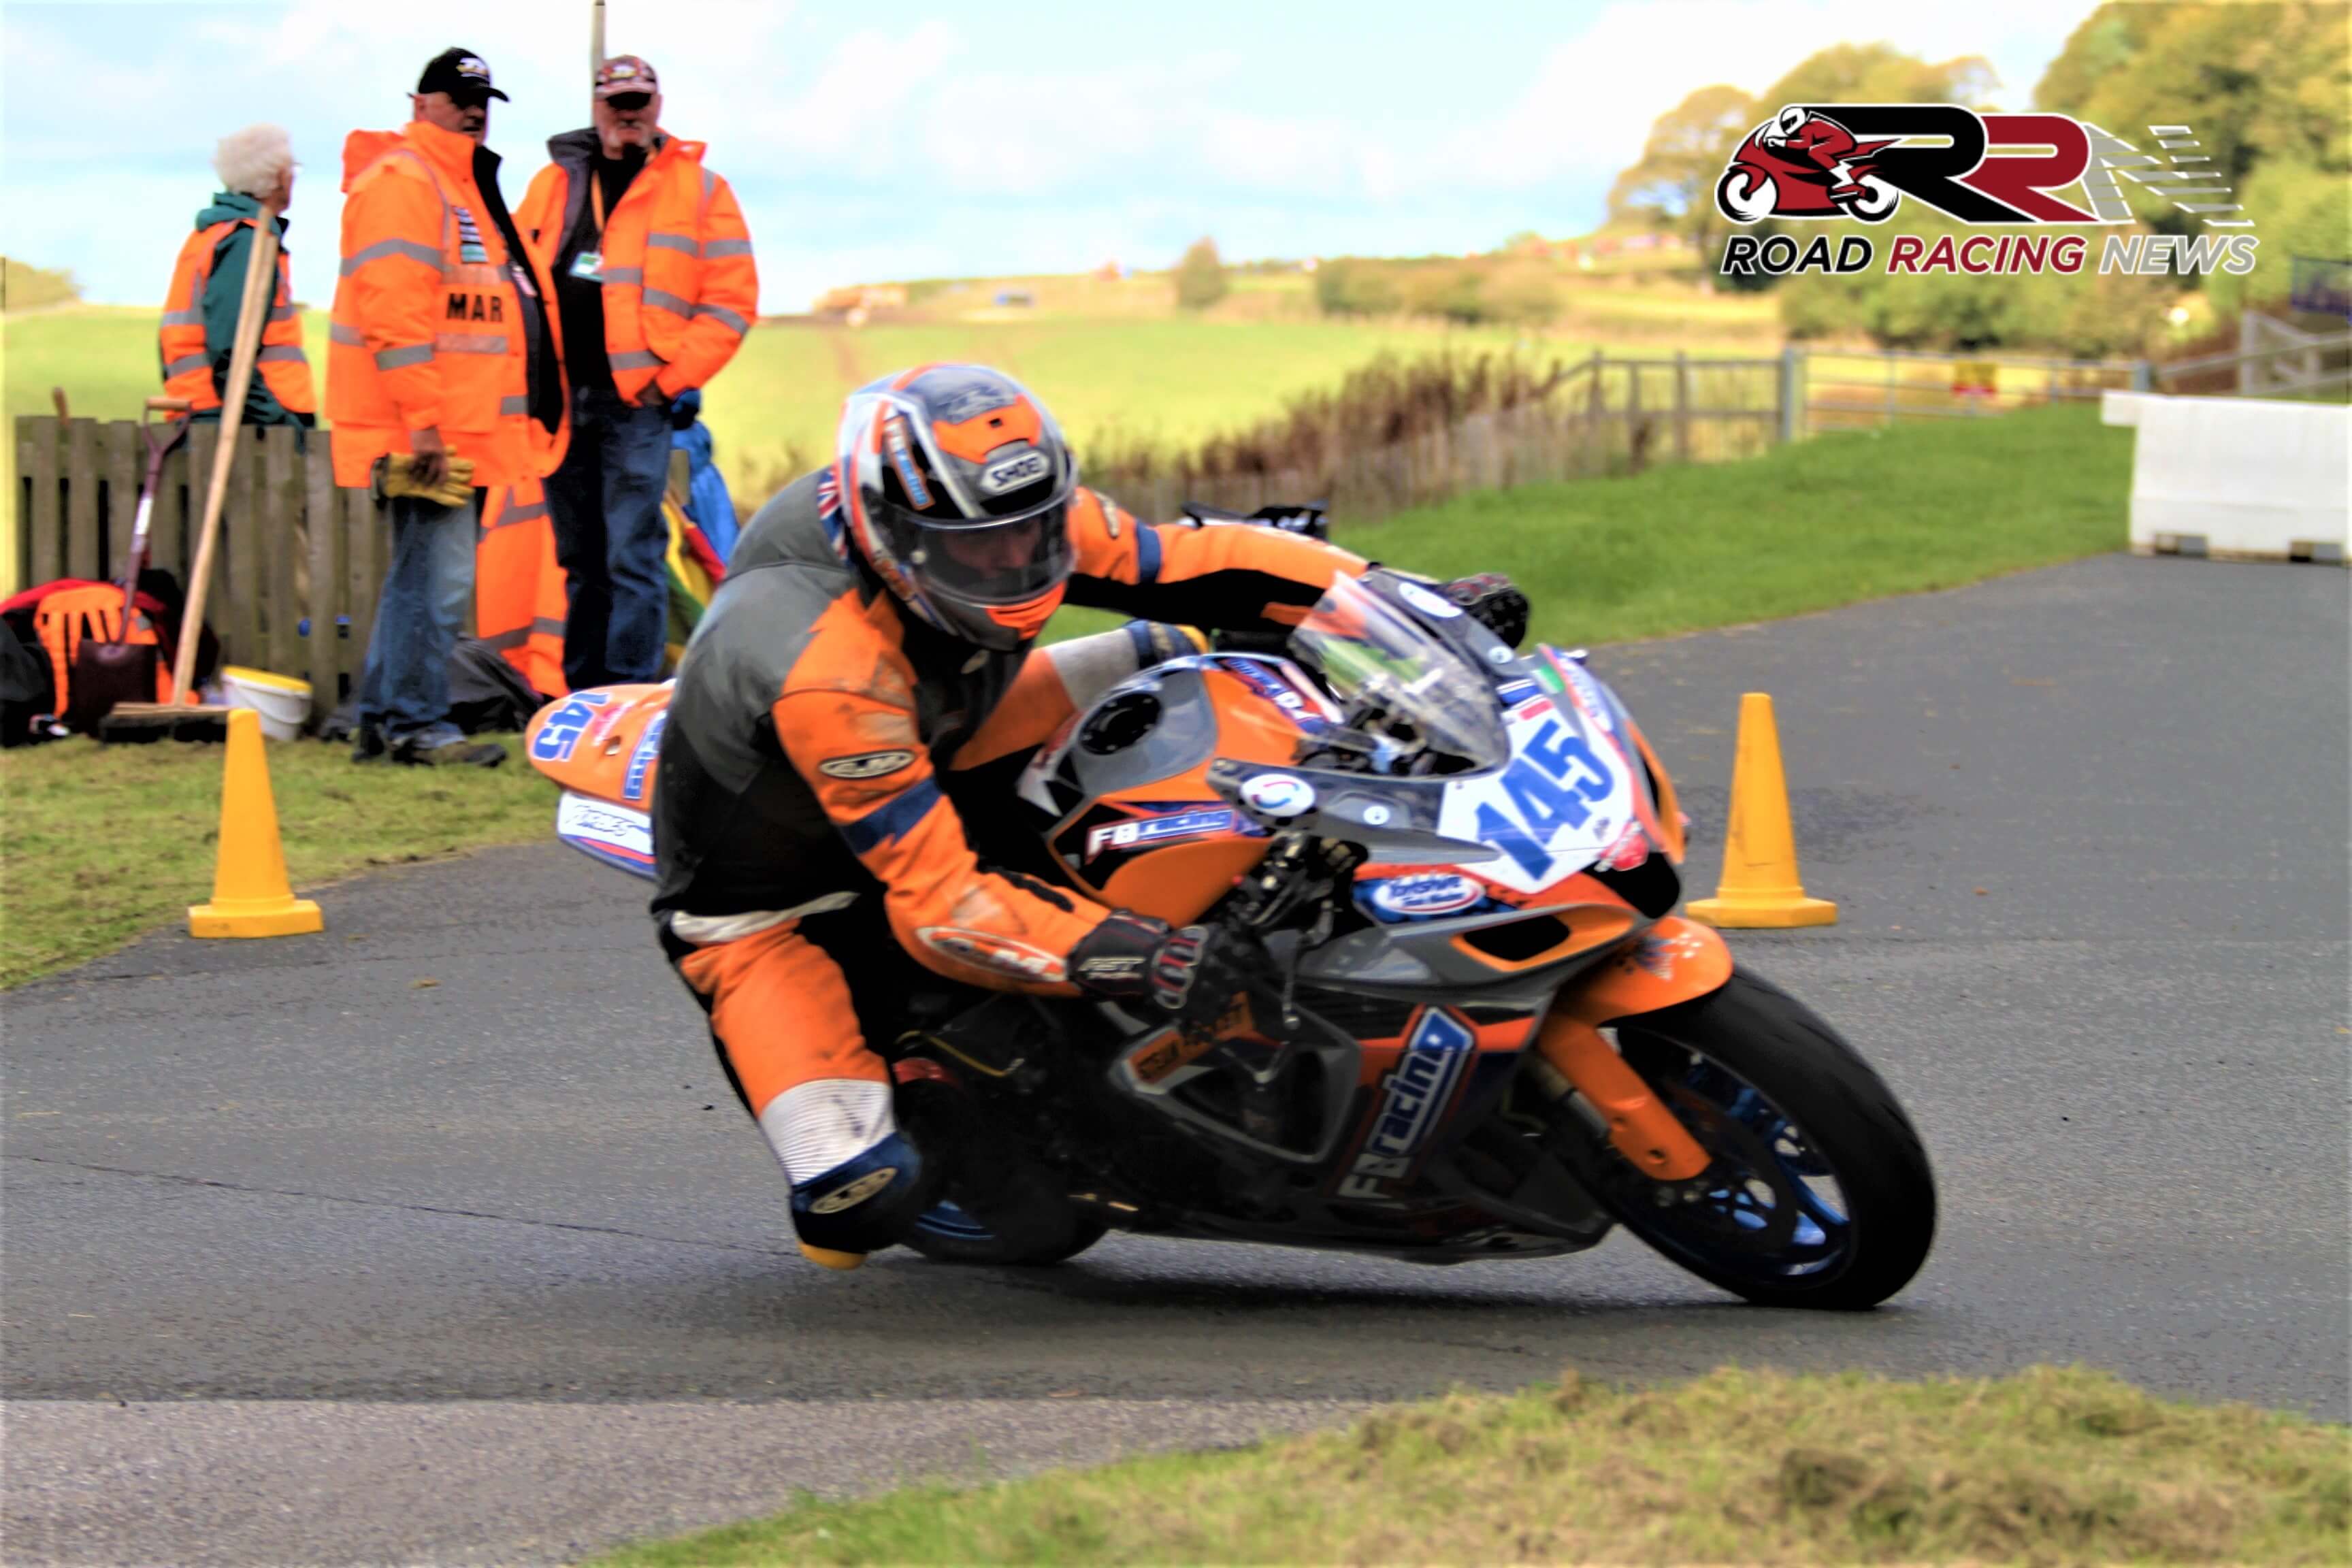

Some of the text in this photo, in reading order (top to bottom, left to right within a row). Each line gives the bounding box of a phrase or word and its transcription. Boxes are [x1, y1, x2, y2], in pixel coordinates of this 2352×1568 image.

[446, 293, 503, 323] MAR
[533, 691, 608, 760] 145
[1476, 720, 1615, 880] 145
